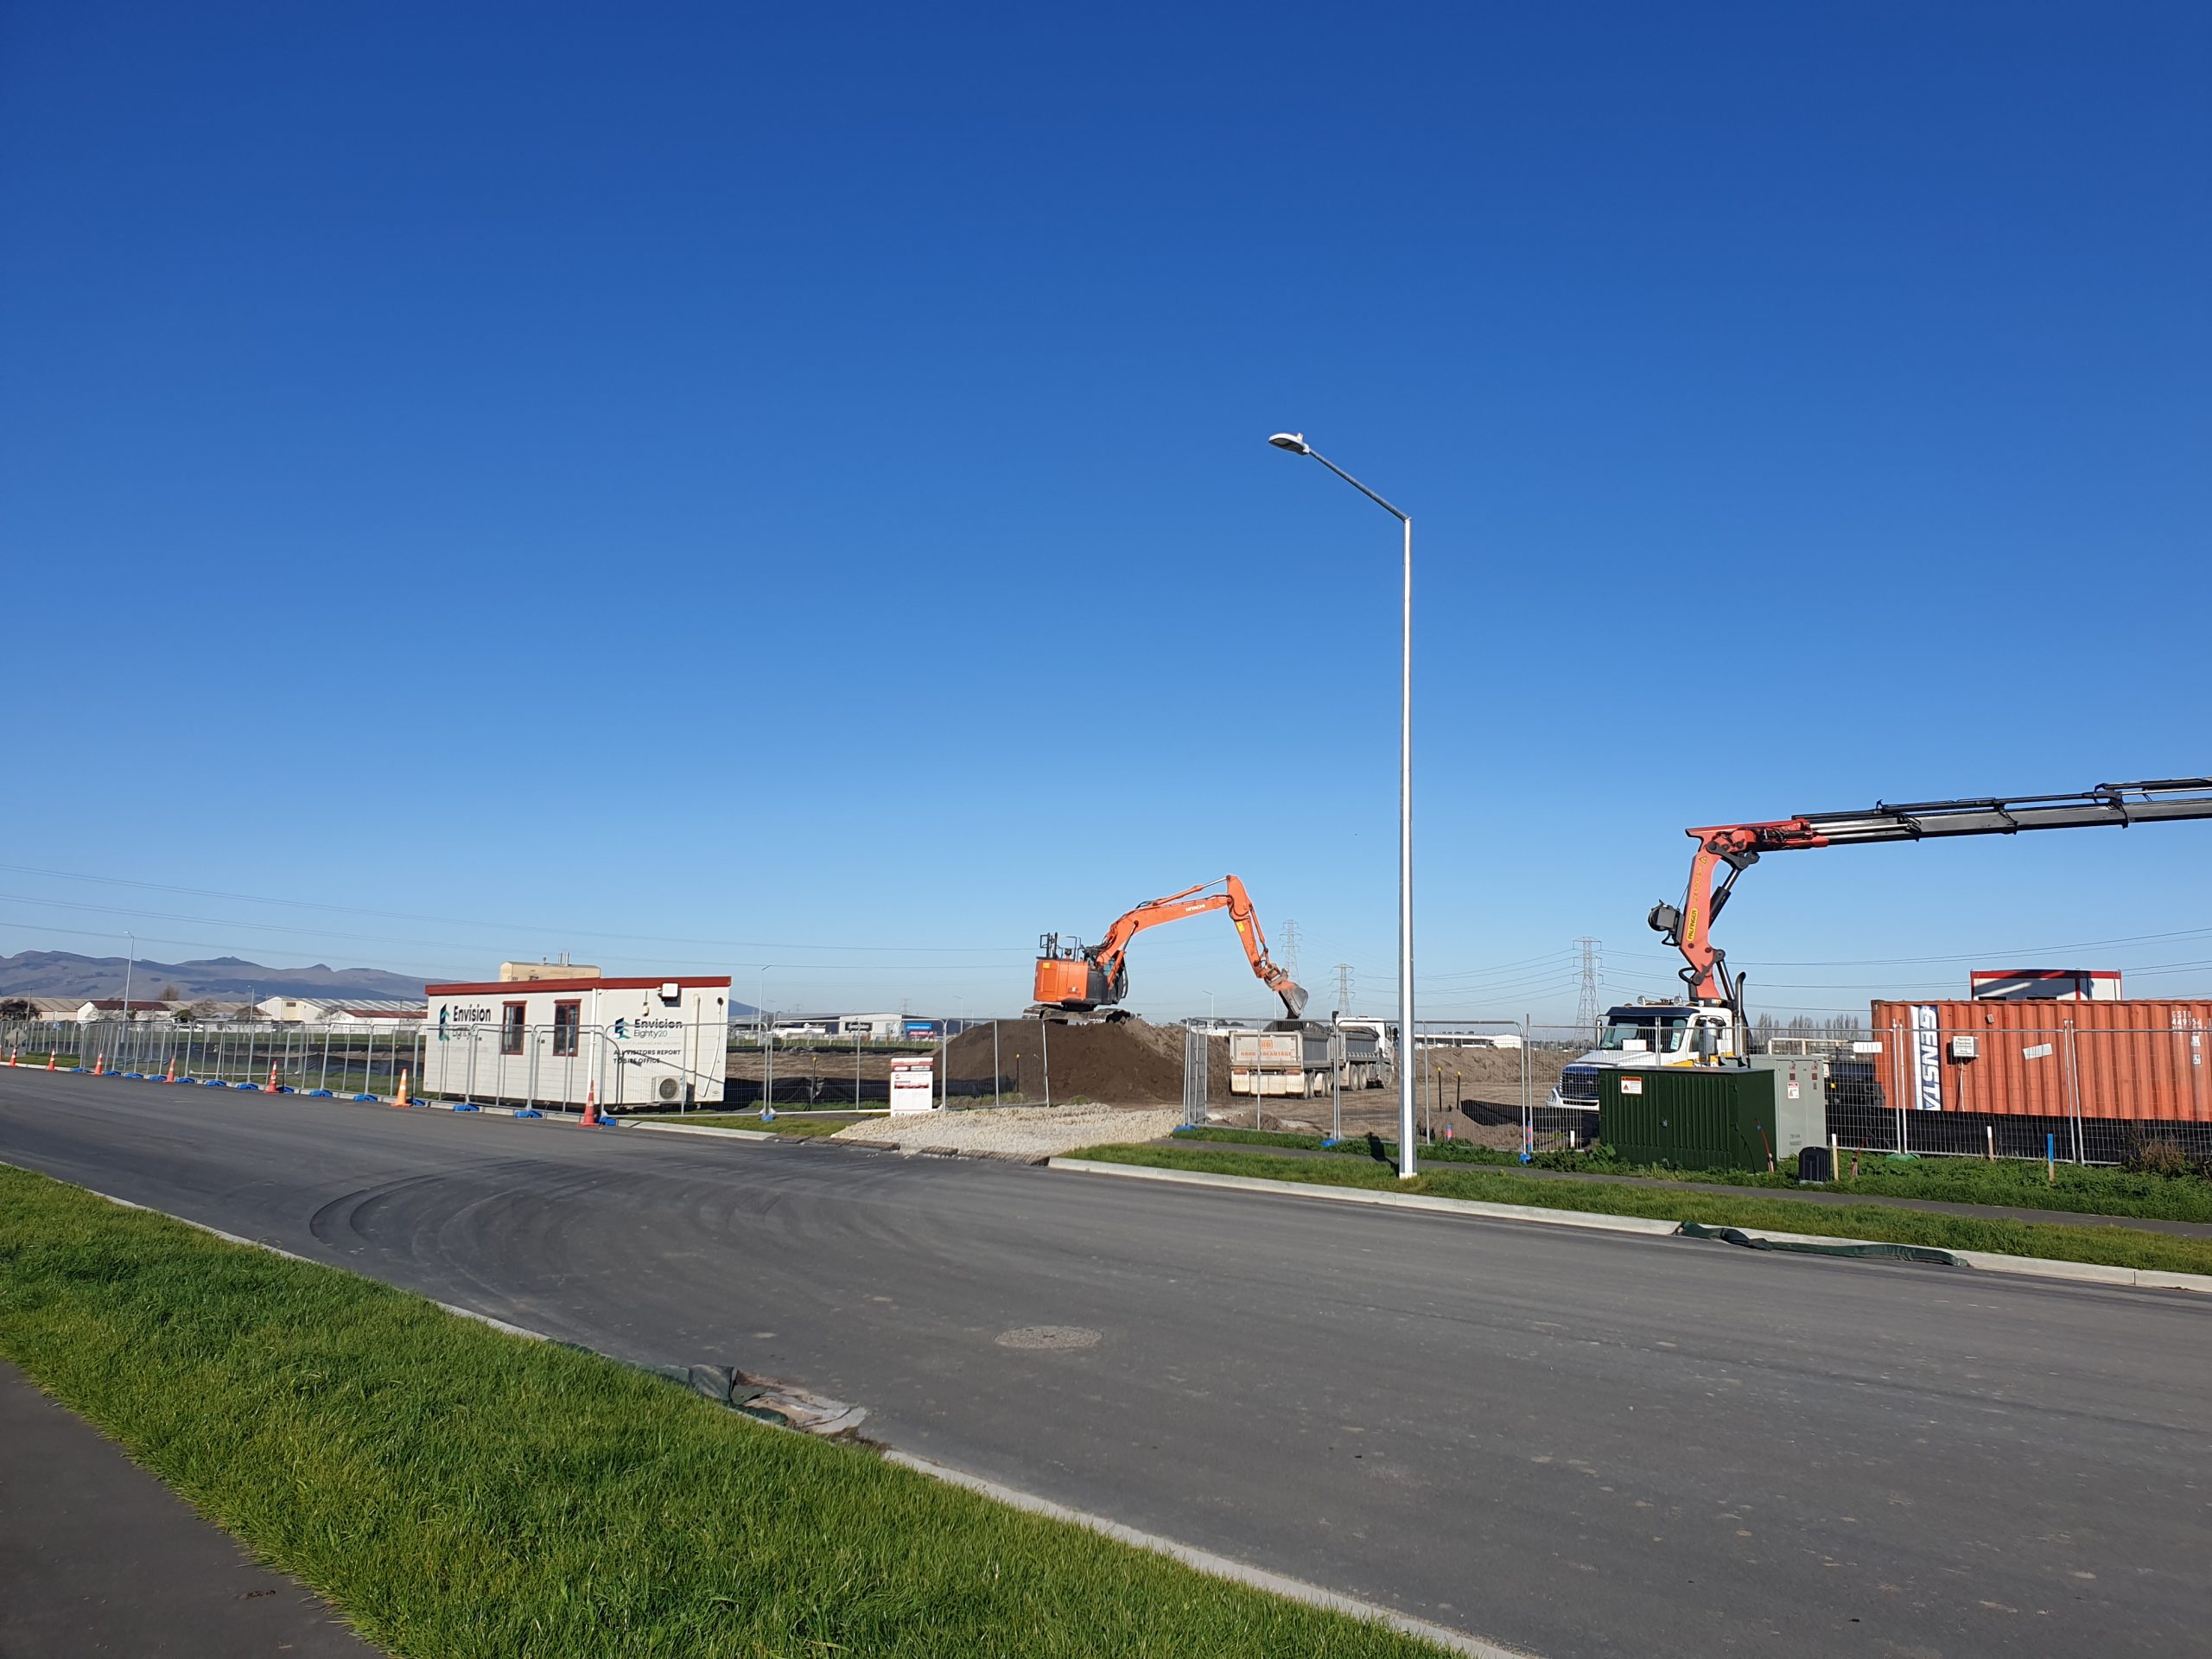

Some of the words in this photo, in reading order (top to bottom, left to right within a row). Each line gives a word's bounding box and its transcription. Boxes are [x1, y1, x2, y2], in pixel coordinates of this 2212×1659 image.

[1688, 910, 1697, 939] PALFINGER
[454, 1004, 491, 1021] Envision
[634, 1019, 683, 1028] Envision
[633, 1029, 668, 1039] Eighty20
